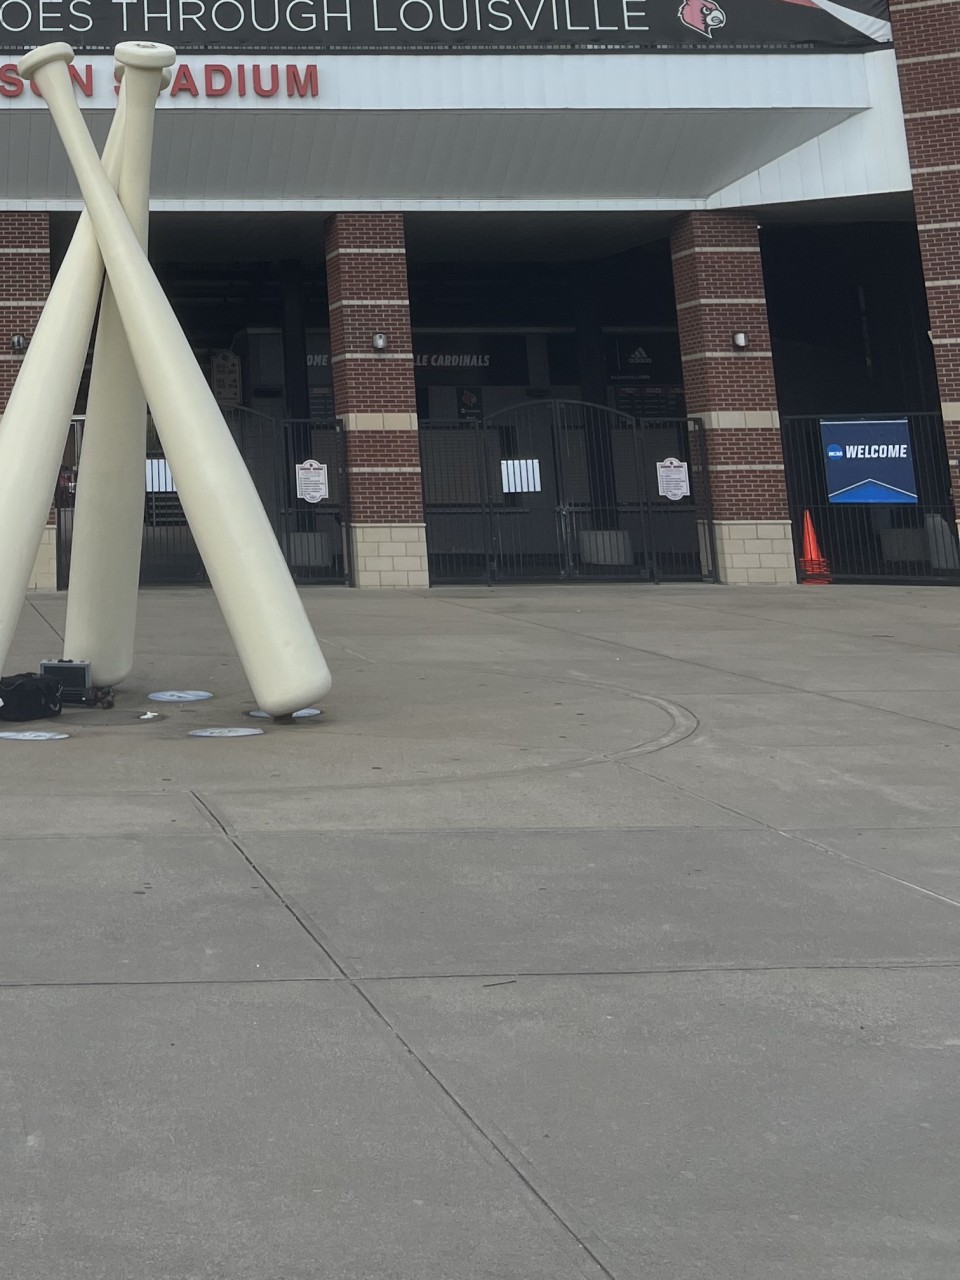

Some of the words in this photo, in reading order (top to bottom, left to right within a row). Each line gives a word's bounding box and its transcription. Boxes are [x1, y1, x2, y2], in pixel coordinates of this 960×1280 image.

[114, 63, 319, 98] ADIUM
[430, 354, 490, 367] CARDINALS
[845, 444, 908, 459] WELCOME
